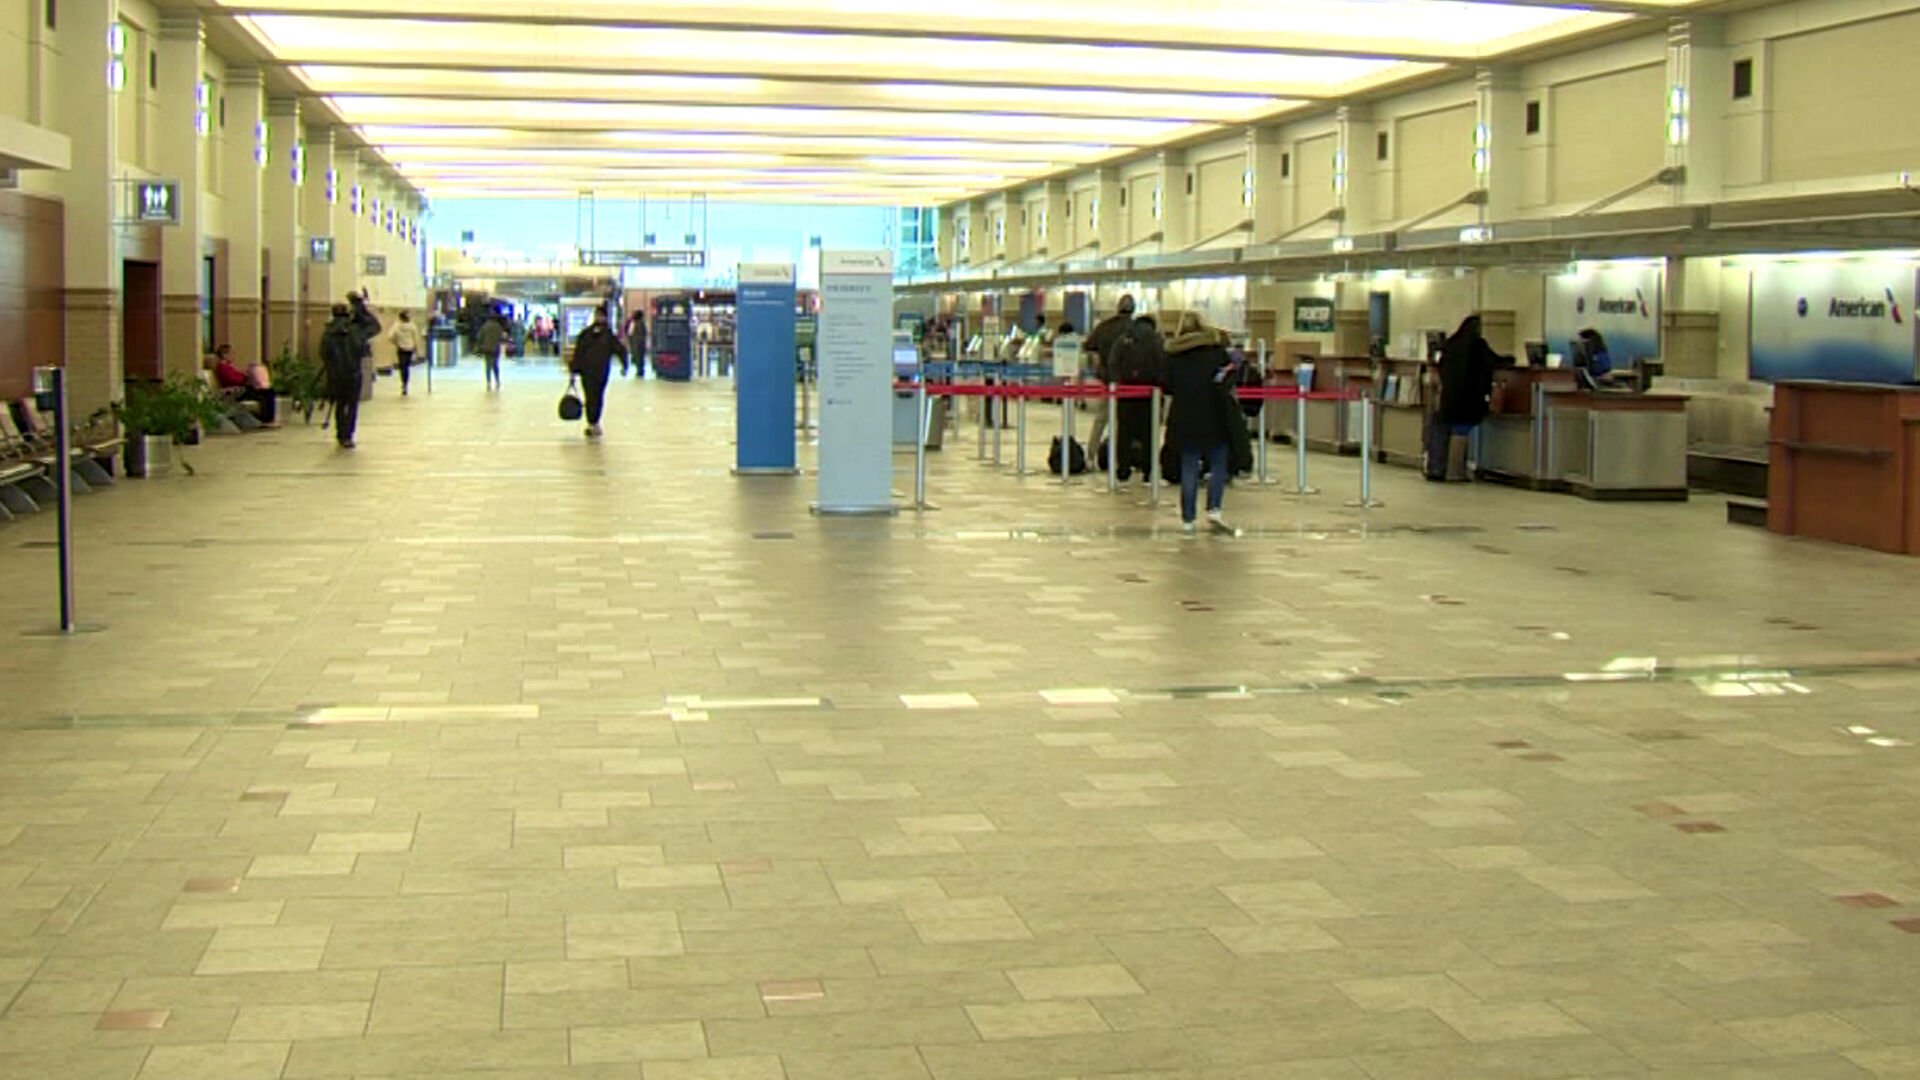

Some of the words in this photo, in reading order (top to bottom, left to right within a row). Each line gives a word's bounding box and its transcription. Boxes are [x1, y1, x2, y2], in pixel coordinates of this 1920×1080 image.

[826, 284, 872, 293] PRIORITY
[1599, 297, 1637, 314] American
[1828, 296, 1885, 317] American
